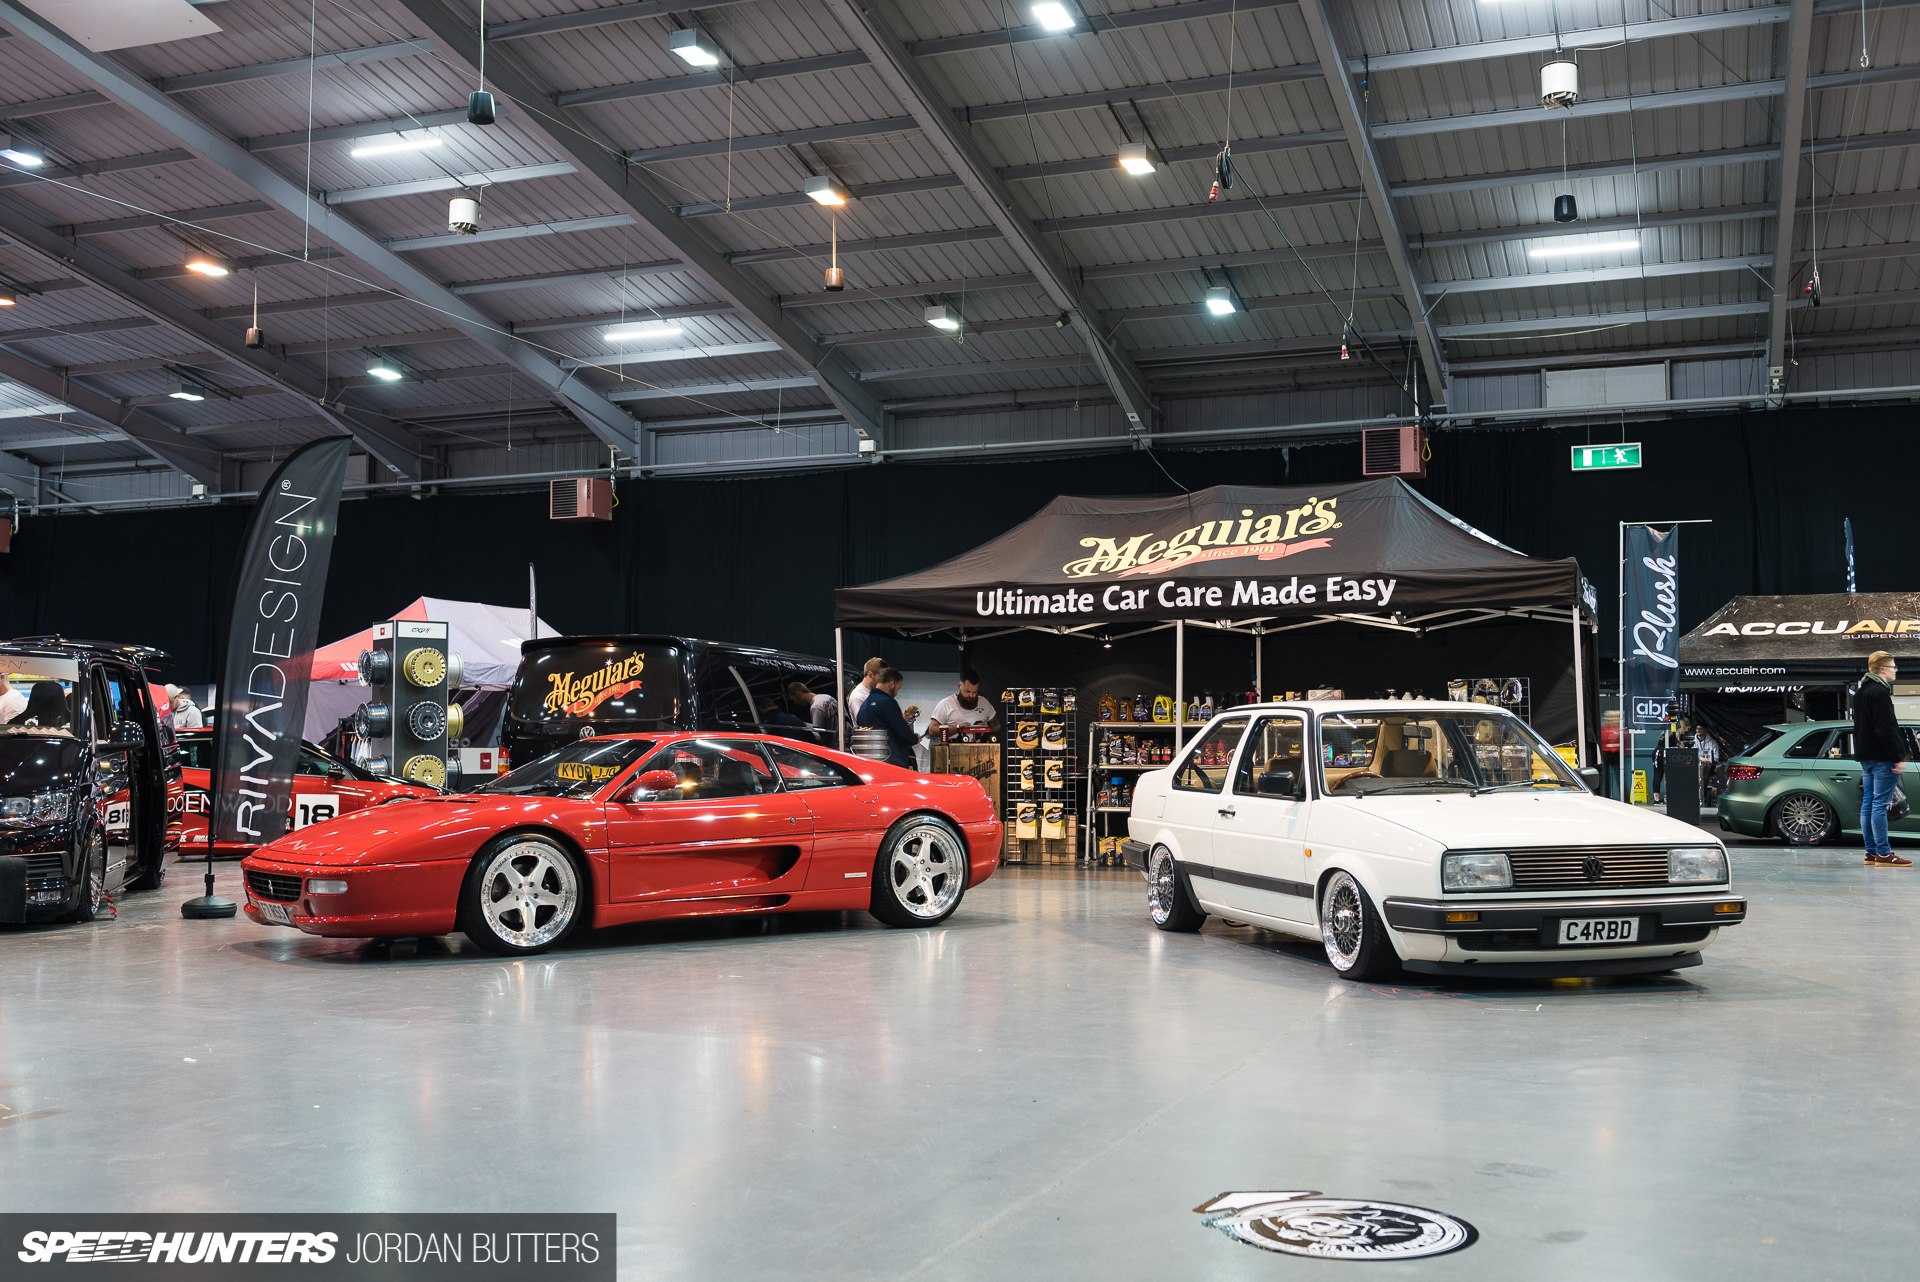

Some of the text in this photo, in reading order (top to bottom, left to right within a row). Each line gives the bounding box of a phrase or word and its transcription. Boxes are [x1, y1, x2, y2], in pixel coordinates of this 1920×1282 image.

[1062, 497, 1338, 579] Meguiar's
[1200, 544, 1276, 559] since 1901
[976, 576, 1396, 616] Ultimate Car Care Made Easy
[1633, 555, 1679, 668] Plush
[545, 651, 645, 714] Meguiar's
[1685, 665, 1786, 676] www.accuair.com
[299, 804, 335, 826] 18
[1566, 920, 1632, 941] C4RBD
